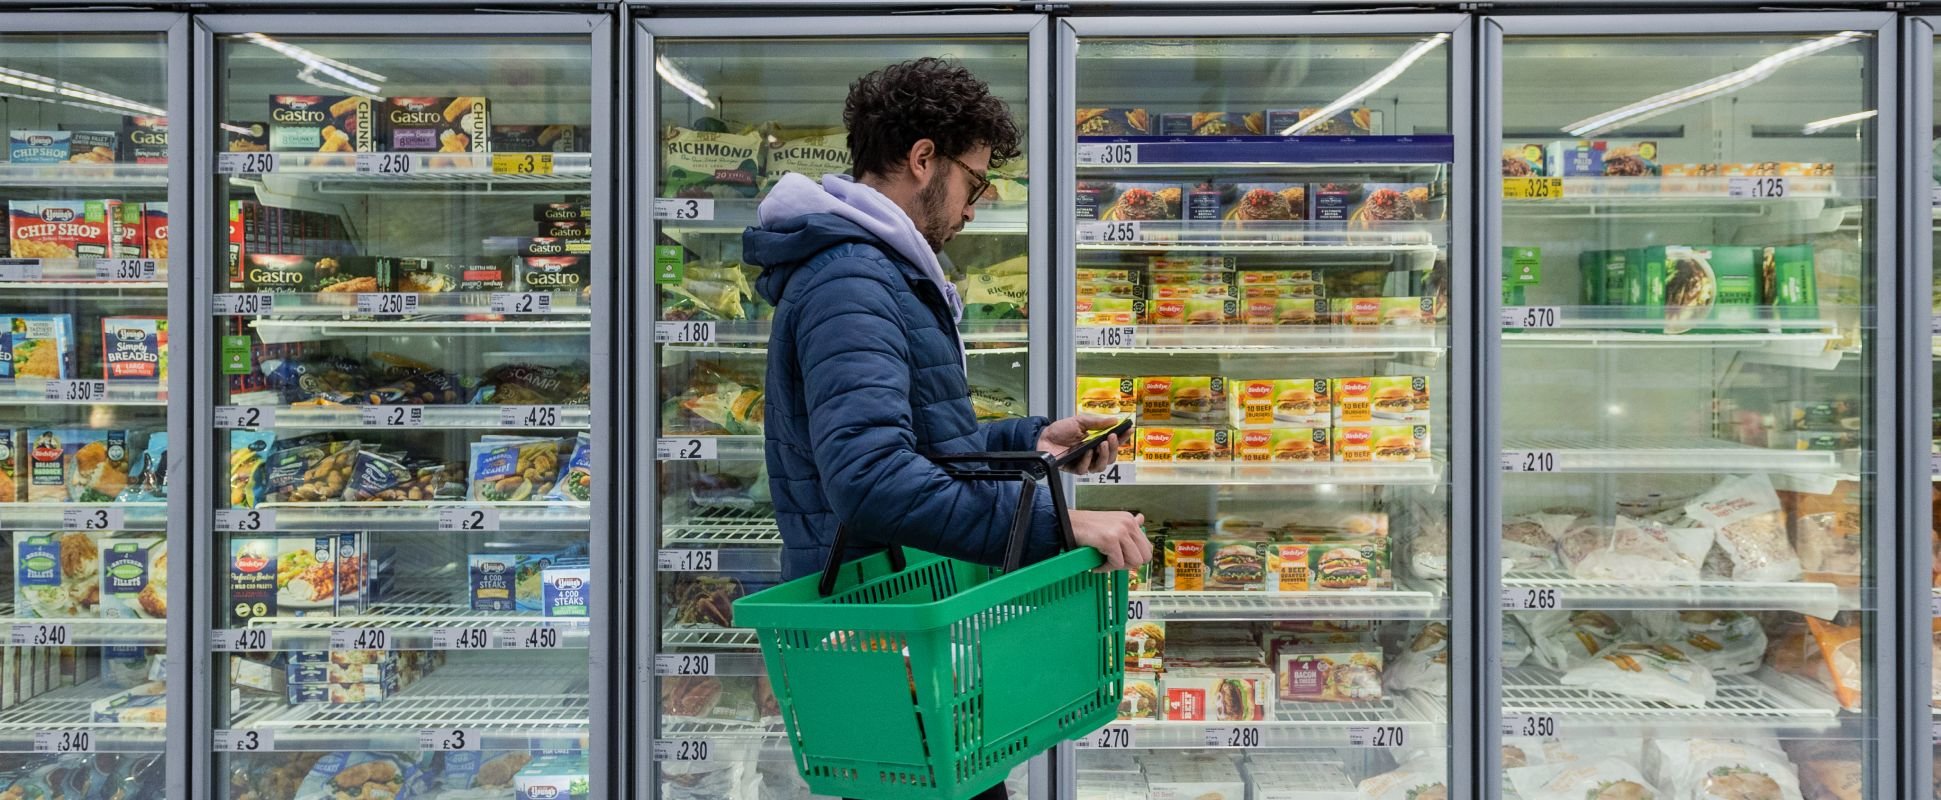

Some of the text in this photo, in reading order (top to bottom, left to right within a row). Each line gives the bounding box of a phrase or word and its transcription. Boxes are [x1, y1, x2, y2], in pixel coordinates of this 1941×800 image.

[272, 108, 325, 123] Gastro
[390, 110, 441, 124] Gastro
[13, 148, 67, 159] CHIP SHOP
[668, 141, 753, 159] RICHMOND
[1100, 144, 1132, 163] £3.05
[242, 153, 273, 173] £2.50
[379, 154, 409, 173] £2.50
[517, 155, 535, 174] £3
[1525, 178, 1549, 198] £3.25
[1752, 178, 1784, 198] £1.25
[545, 210, 577, 219] Gastro
[676, 200, 699, 219] £3
[17, 224, 101, 239] CHIP SHOP
[550, 228, 582, 237] Gastro
[1103, 222, 1134, 241] £2.55
[529, 243, 562, 254] Gastro
[117, 260, 141, 279] £3.50
[249, 268, 303, 284] Gastro
[525, 271, 580, 286] Gastro
[234, 295, 258, 313] £2.50
[379, 294, 403, 313] £2.50
[515, 294, 533, 313] £2
[1523, 308, 1554, 327] £5.70
[678, 322, 709, 342] £1.80
[1097, 327, 1121, 346] £1.85
[108, 353, 158, 362] BREADED
[116, 342, 148, 354] Simply
[66, 382, 91, 400] £3.50
[237, 407, 260, 427] £2
[387, 407, 405, 426] £2
[524, 407, 555, 426] £4.25
[680, 439, 702, 459] £2
[1522, 452, 1553, 472] £2.10
[1098, 464, 1122, 484] £4
[86, 510, 108, 529] £3
[238, 511, 261, 530] £3
[462, 510, 484, 530] £2
[681, 551, 712, 570] £1.25
[479, 580, 507, 589] STEAKS
[554, 597, 584, 606] STEAKS
[1524, 589, 1555, 609] £2.65
[34, 626, 65, 644] £3.40
[235, 630, 266, 649] £4.20
[354, 630, 385, 649] £4.20
[456, 628, 487, 649] £4.50
[525, 628, 556, 648] £4.50
[678, 655, 709, 675] £2.30
[1302, 662, 1309, 670] 4
[1170, 701, 1181, 710] 4
[1523, 716, 1554, 736] £3.50
[58, 732, 89, 751] £3.40
[237, 730, 260, 751] £3
[442, 730, 466, 750] £3
[1098, 728, 1129, 748] £2.70
[1228, 727, 1259, 747] £2.80
[1372, 726, 1404, 746] £2.70
[676, 741, 708, 761] £2.30
